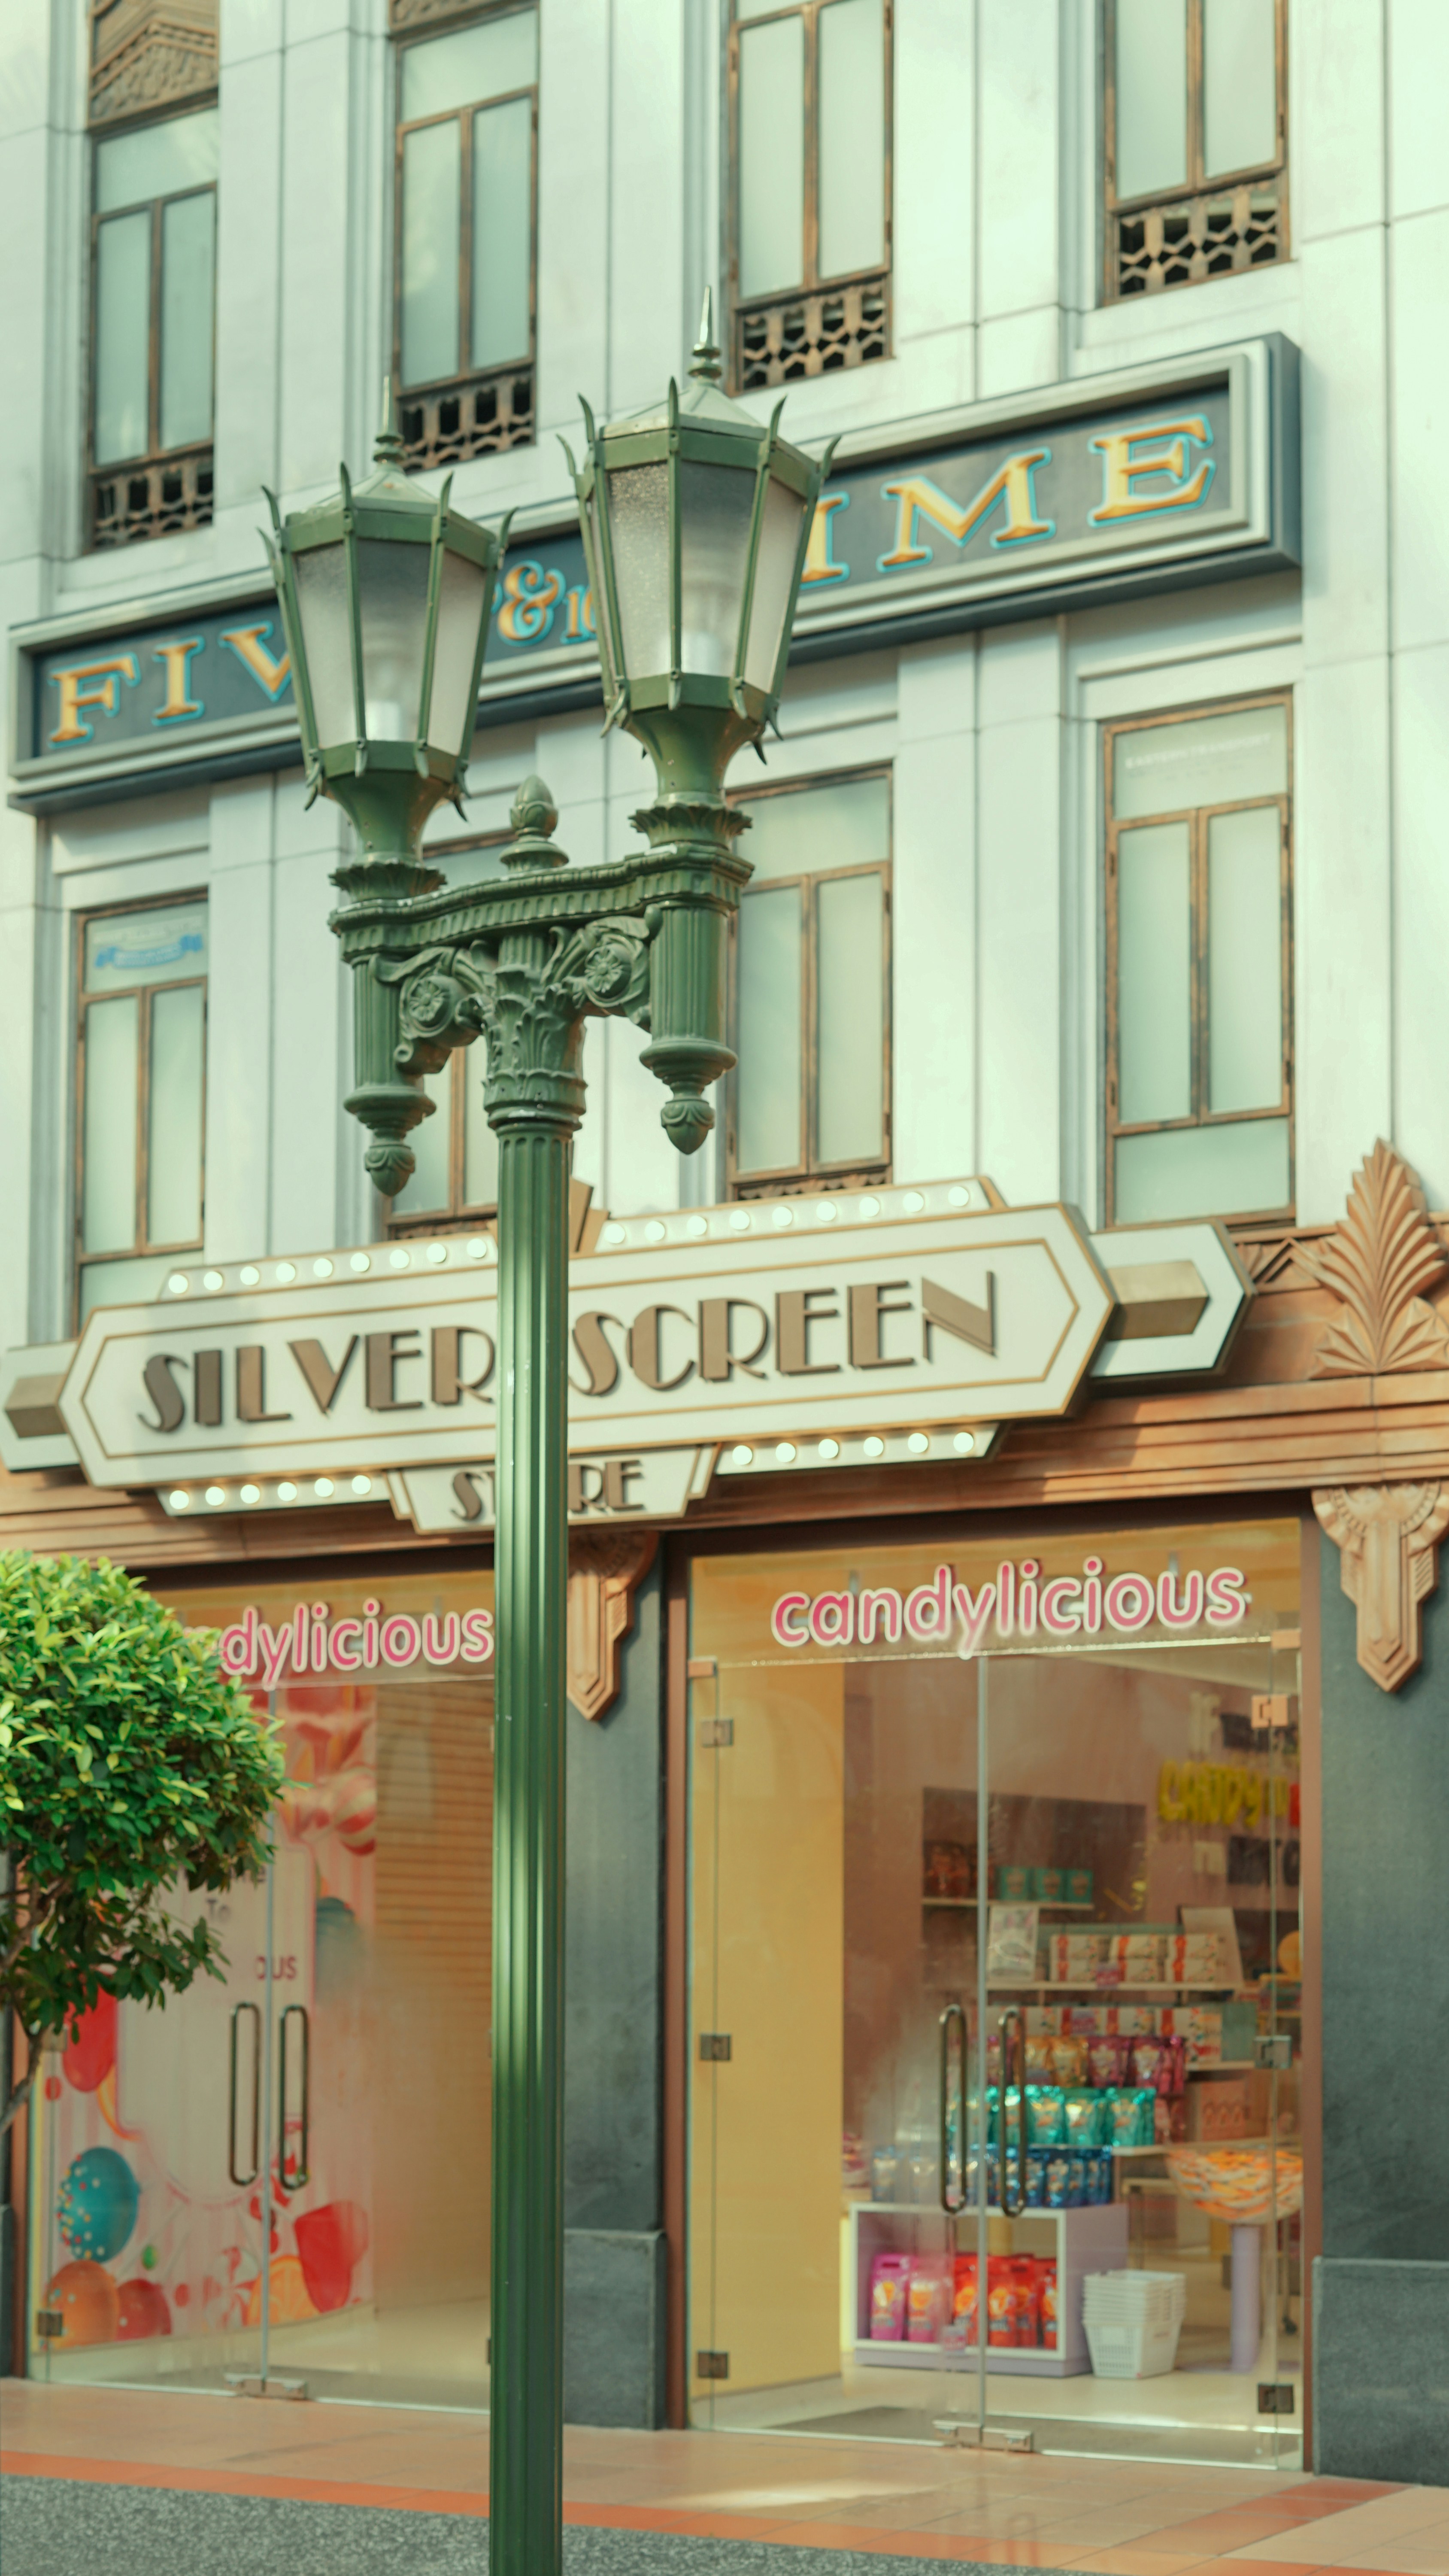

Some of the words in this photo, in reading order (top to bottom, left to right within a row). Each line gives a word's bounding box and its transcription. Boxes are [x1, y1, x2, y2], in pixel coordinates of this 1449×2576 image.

[48, 620, 292, 748] FIV
[801, 413, 1216, 590] IME
[137, 1326, 494, 1433] SILVER
[568, 1270, 997, 1395] SCREEN
[450, 1459, 645, 1521] SRE
[184, 1597, 494, 1691] dylicious
[772, 1555, 1247, 1660] candylicious
